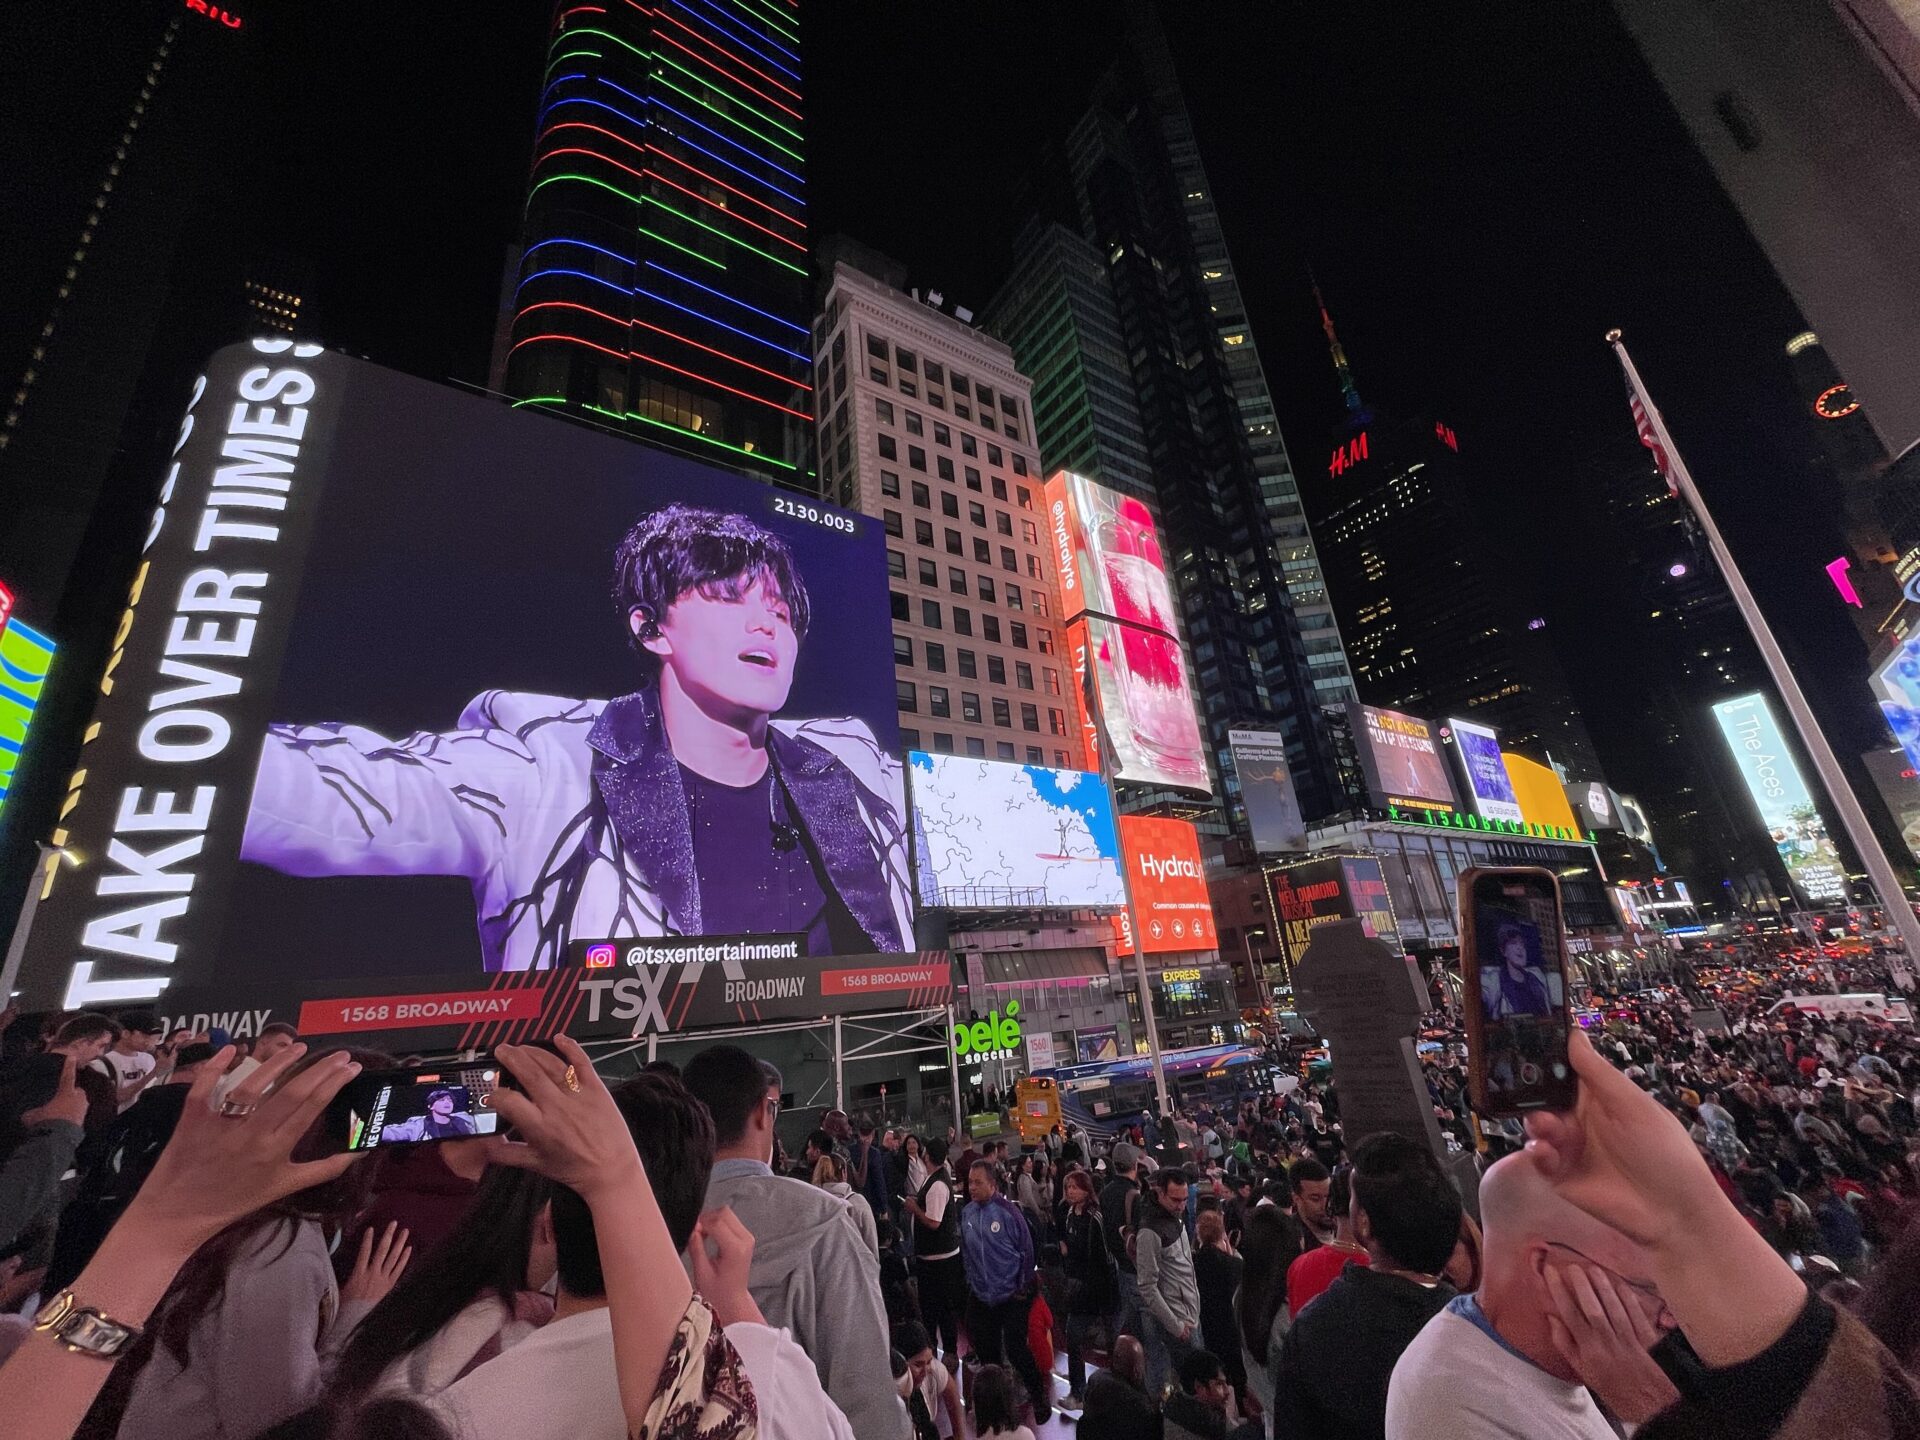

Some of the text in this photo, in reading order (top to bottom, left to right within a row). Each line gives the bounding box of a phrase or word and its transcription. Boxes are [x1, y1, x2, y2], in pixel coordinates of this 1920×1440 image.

[194, 366, 316, 551] TIMES
[1329, 431, 1368, 479] H&M
[774, 498, 855, 533] 2130.003
[1053, 500, 1075, 590] @hydralyte
[139, 568, 269, 762] OVER
[1442, 736, 1453, 744] LG
[1735, 714, 1785, 798] The Aces
[1424, 809, 1575, 840] 1540 BROADWAY
[63, 786, 216, 1011] TAKE
[1296, 880, 1341, 902] DIAMOND
[626, 940, 798, 967] @tsxentertainment
[841, 970, 933, 988] 1568 BROADWAY
[1162, 969, 1201, 983] EXPRESS
[340, 998, 513, 1023] 1568 BROADWAY
[578, 964, 806, 1033] TSX BROADWAY
[965, 1048, 1013, 1065] SOCCER
